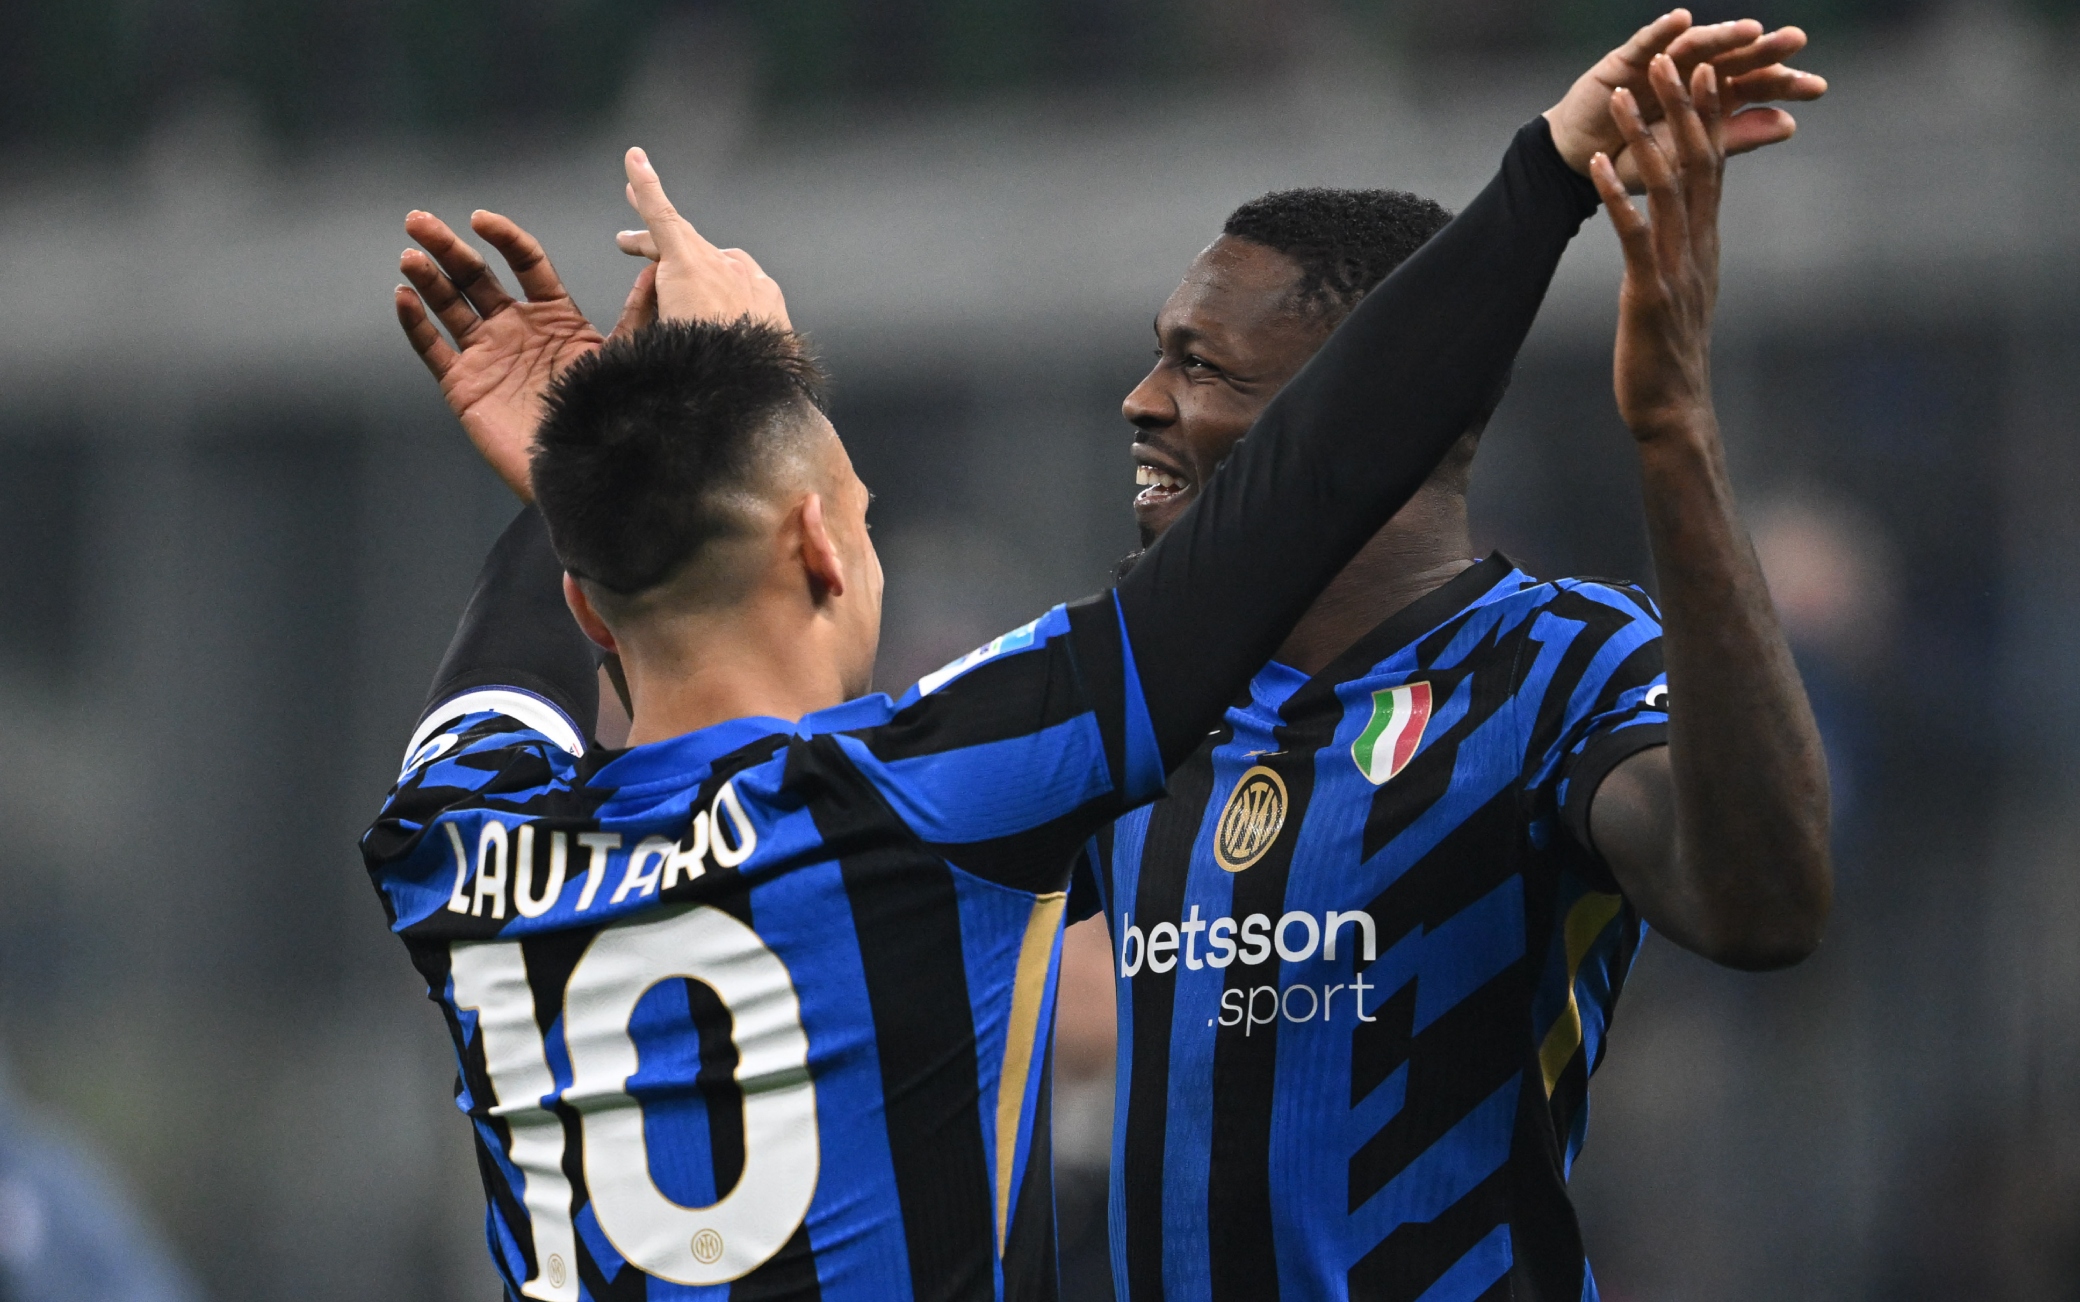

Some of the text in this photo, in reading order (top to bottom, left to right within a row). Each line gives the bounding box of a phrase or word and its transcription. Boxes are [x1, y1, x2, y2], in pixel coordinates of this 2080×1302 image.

[443, 780, 757, 919] LAUTARO
[1120, 904, 1377, 978] betsson
[1207, 972, 1377, 1037] .sport
[449, 904, 821, 1302] 10
